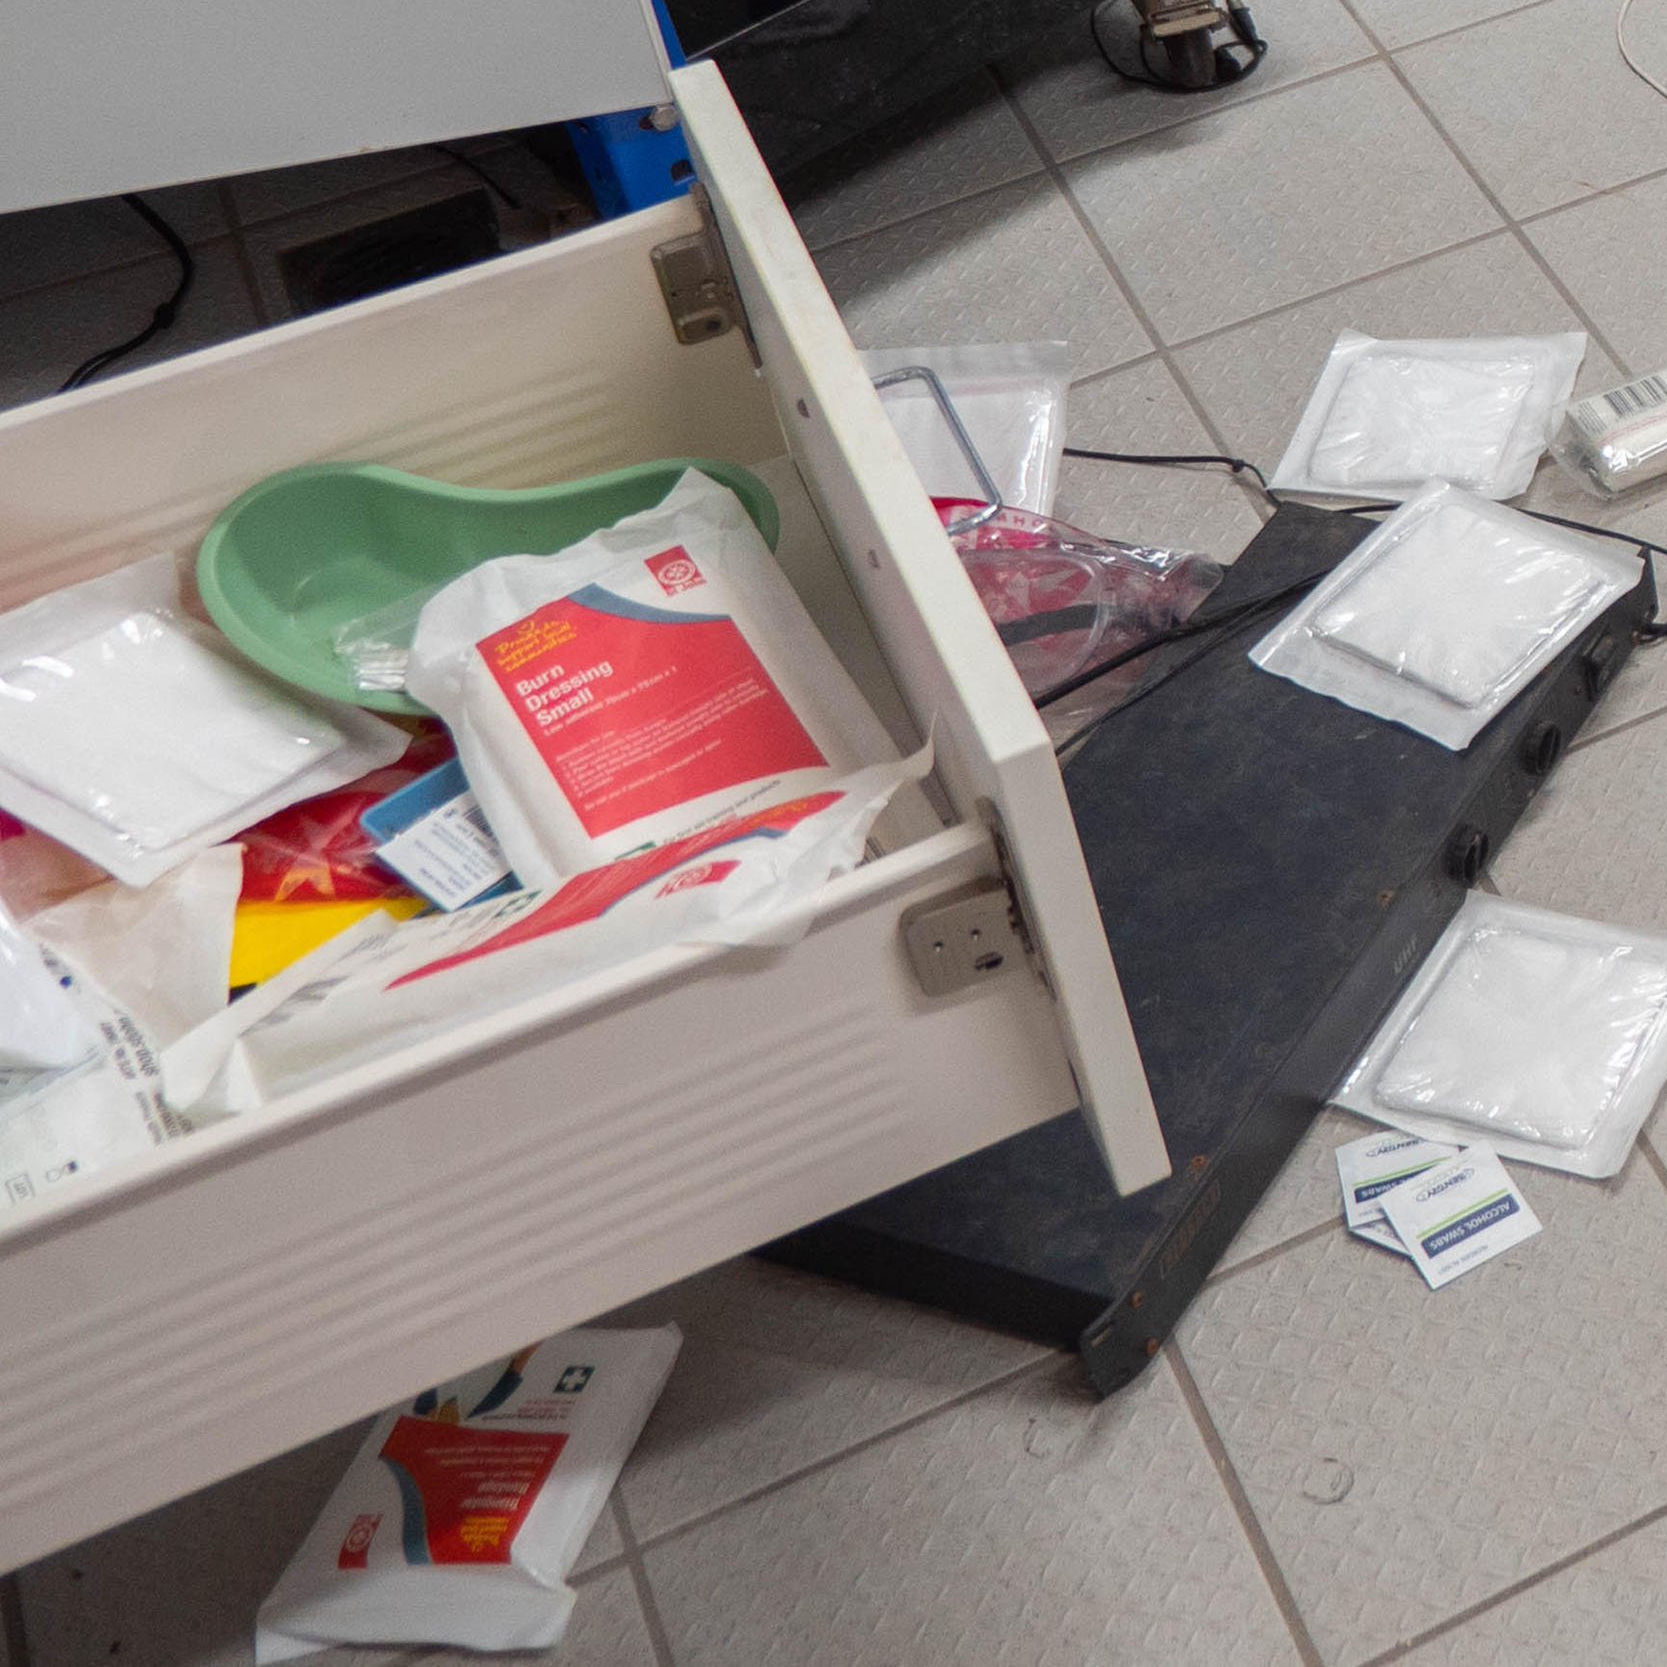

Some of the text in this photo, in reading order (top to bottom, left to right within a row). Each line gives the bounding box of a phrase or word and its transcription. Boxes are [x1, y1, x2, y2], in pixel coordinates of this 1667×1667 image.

[516, 664, 565, 697] Burn
[525, 660, 614, 713] Dressing
[536, 687, 594, 727] Small
[1430, 1201, 1511, 1250] ALCOHOL SWABS
[461, 1497, 520, 1510] Triangular
